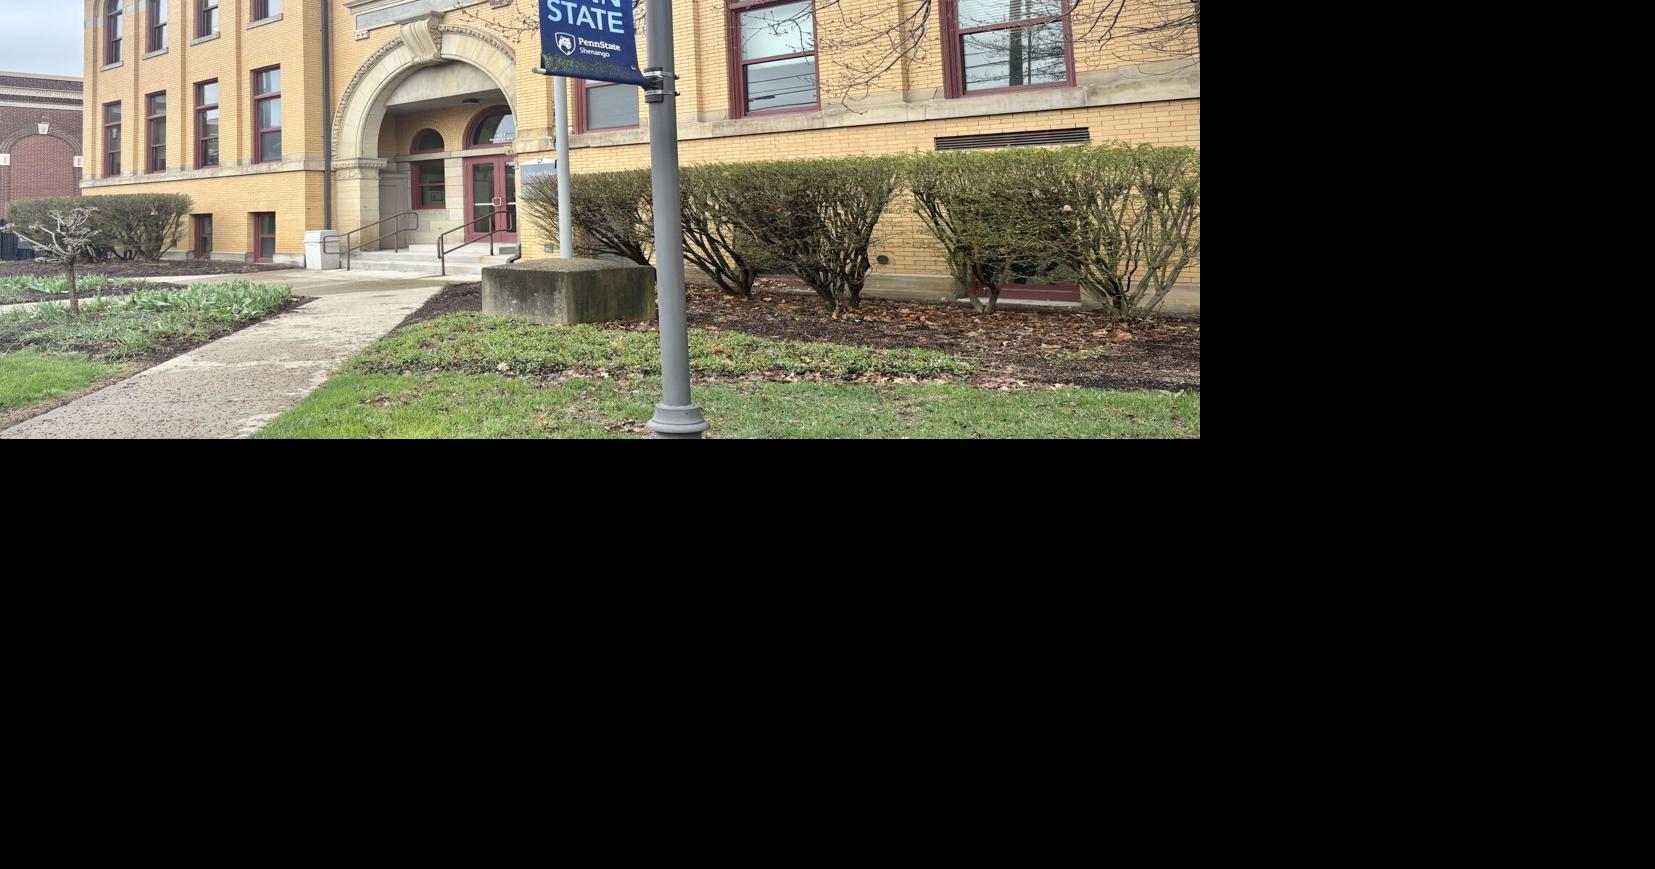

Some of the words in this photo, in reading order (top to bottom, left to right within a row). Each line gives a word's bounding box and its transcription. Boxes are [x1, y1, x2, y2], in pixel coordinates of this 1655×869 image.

[547, 0, 625, 34] STATE
[578, 37, 621, 52] PennState
[580, 47, 611, 59] Shenango
